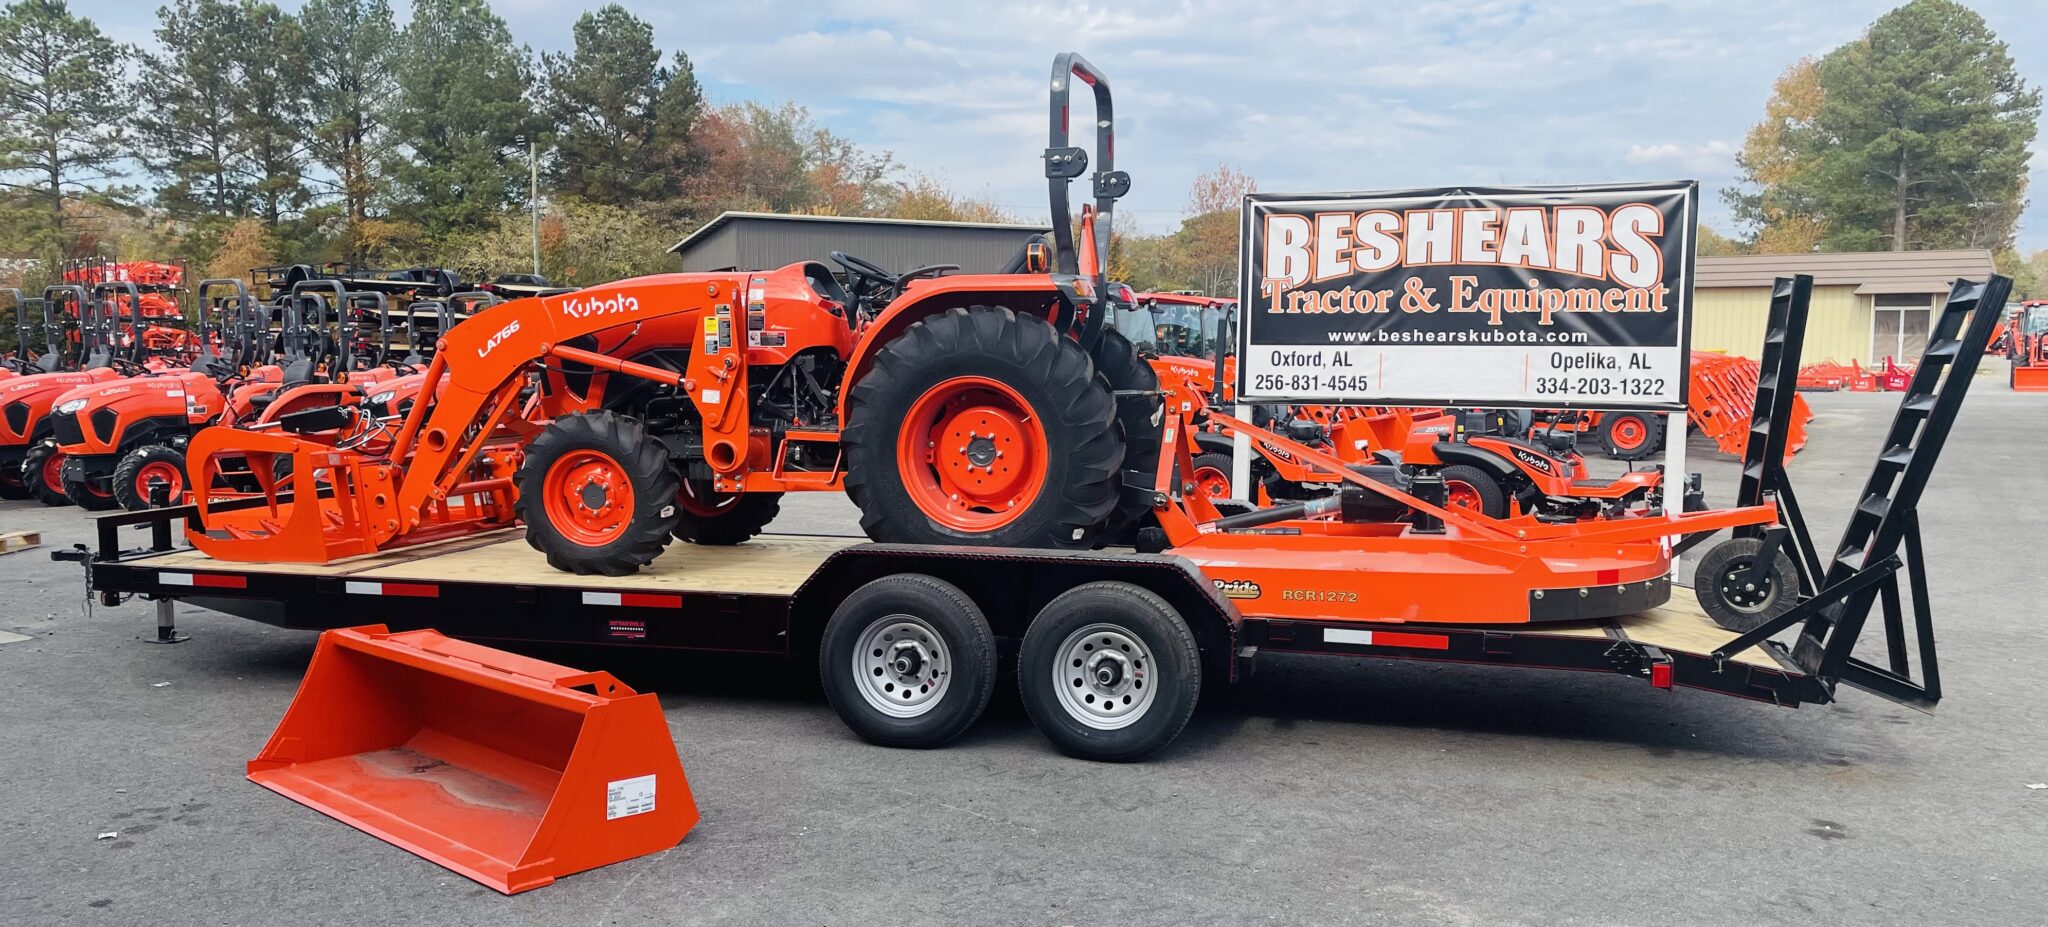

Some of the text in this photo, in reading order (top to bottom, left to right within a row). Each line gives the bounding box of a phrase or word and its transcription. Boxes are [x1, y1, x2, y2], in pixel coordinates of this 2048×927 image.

[1262, 203, 1664, 297] BESHEARS
[563, 293, 639, 318] Kubota
[1262, 275, 1668, 325] Tractor & Equipment
[478, 320, 520, 358] LA766
[1328, 328, 1588, 343] www.beshearskubota.com
[1271, 350, 1353, 369] Oxford, AL
[1550, 352, 1652, 372] Opelika, AL
[1170, 365, 1199, 377] Kubota
[1255, 374, 1368, 391] 256-831-4545
[1536, 377, 1665, 396] 334-203-1322
[1263, 441, 1290, 459] Kubota
[1518, 451, 1549, 470] Kubota
[1214, 580, 1259, 593] Pride
[1282, 590, 1358, 602] RCR1272
